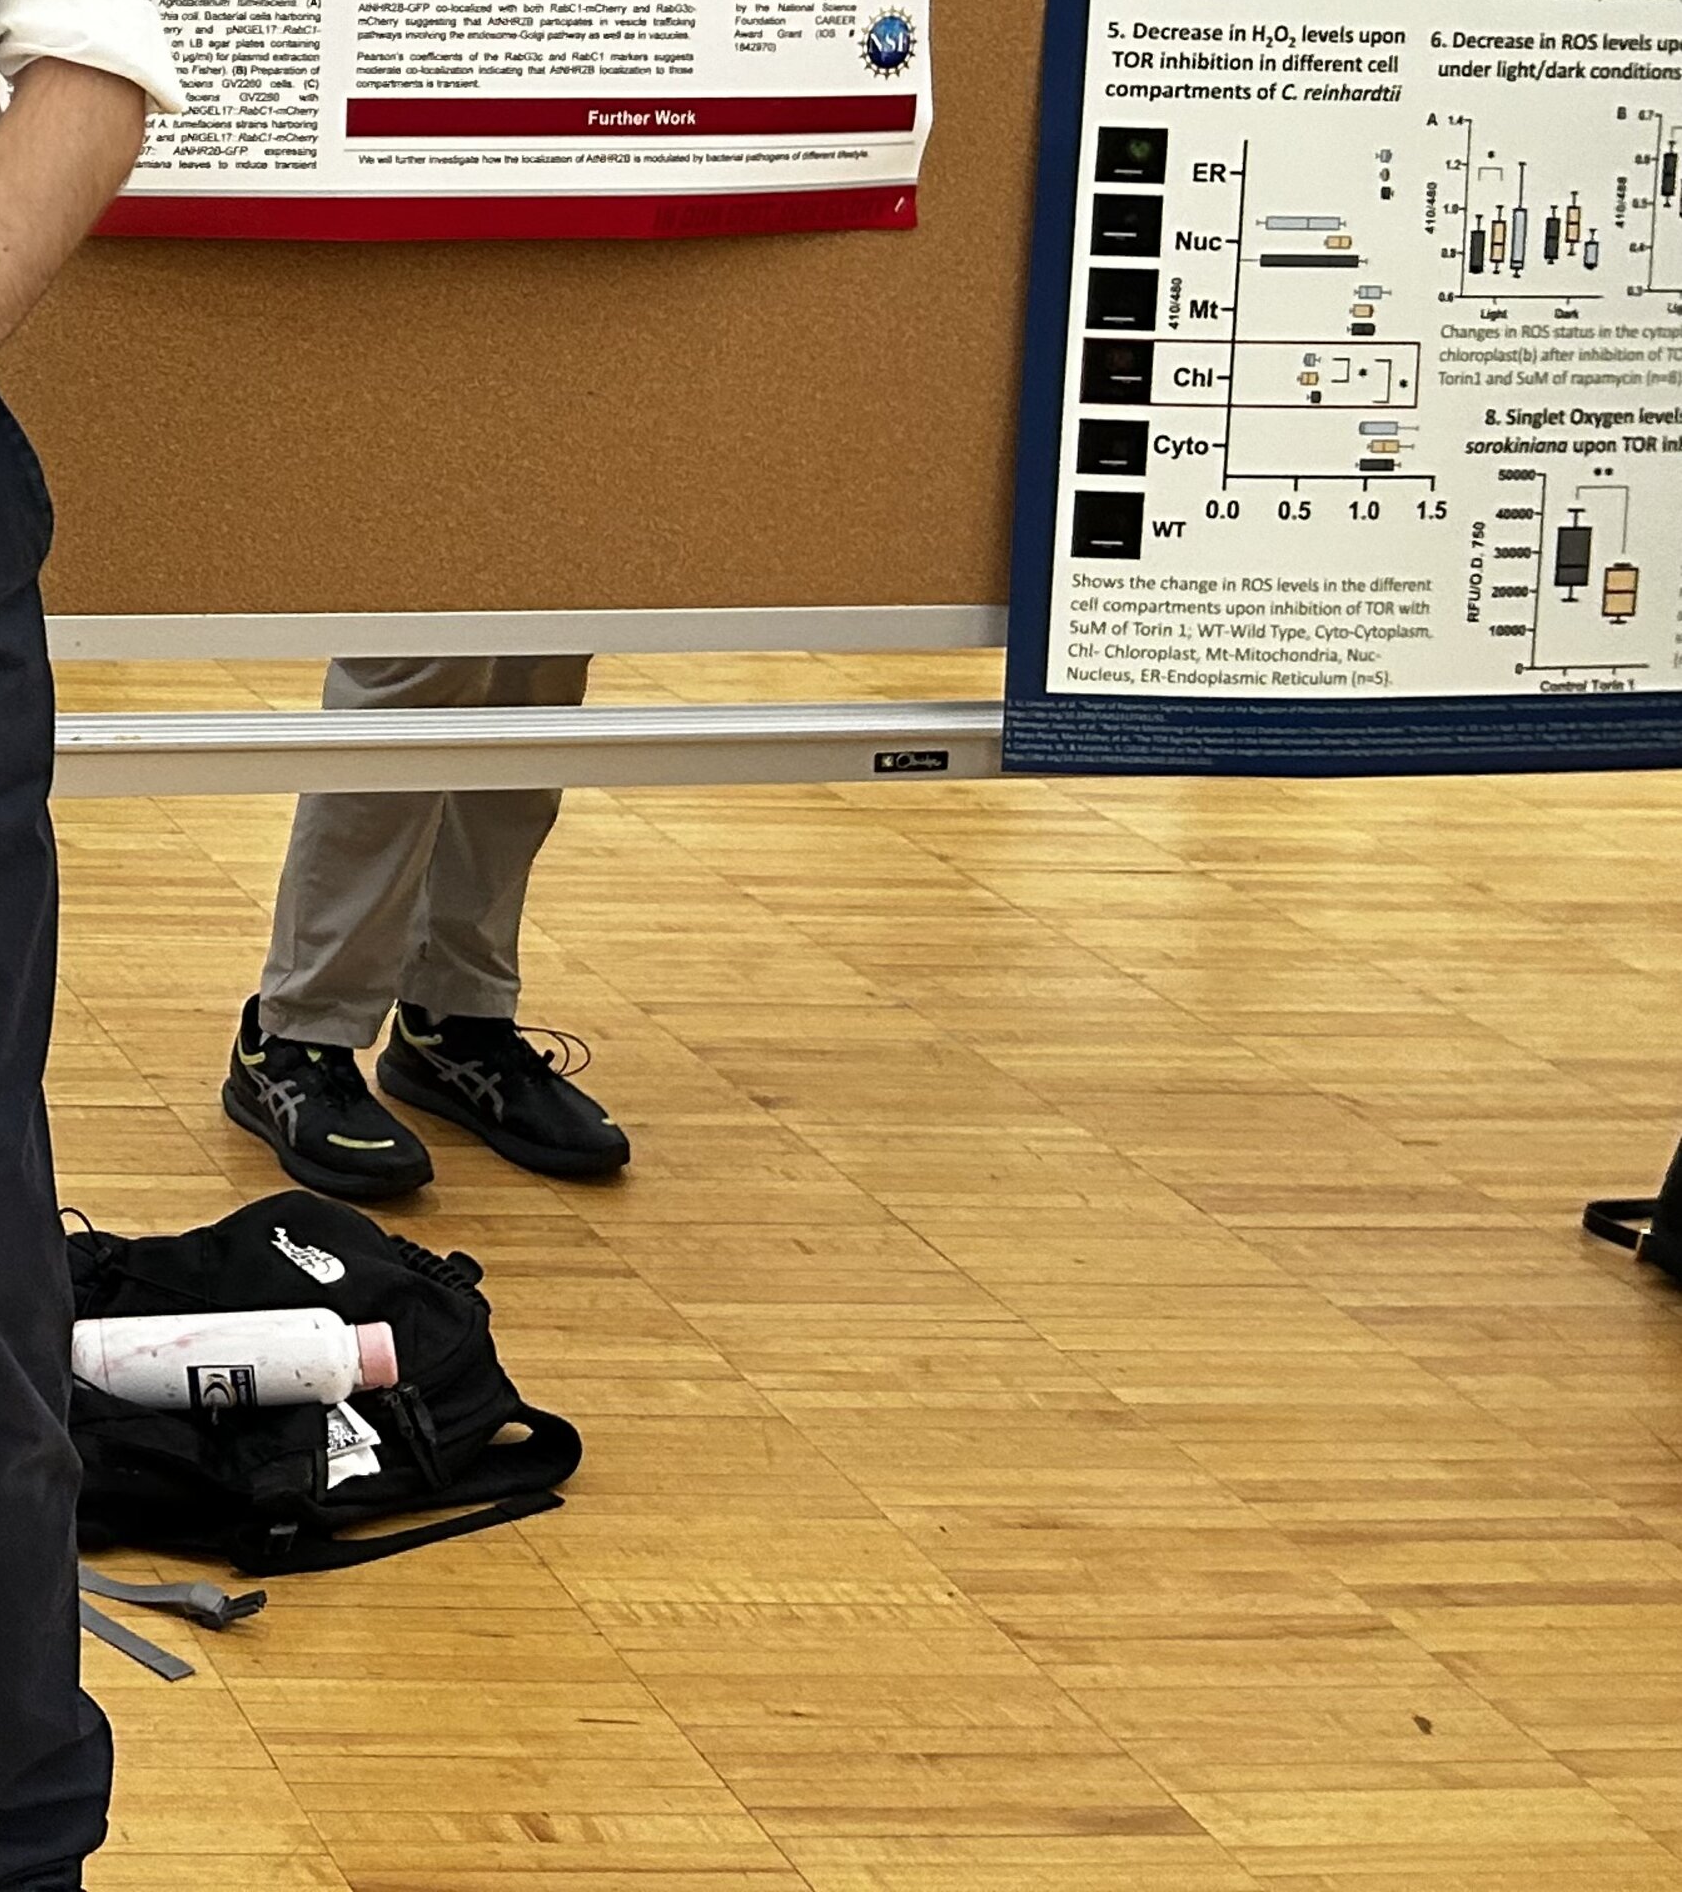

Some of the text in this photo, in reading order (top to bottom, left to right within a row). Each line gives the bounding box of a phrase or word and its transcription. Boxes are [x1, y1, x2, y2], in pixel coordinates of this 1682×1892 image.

[1107, 21, 1124, 38] 5.
[1132, 22, 1222, 40] Decrease
[1228, 24, 1245, 41] in
[1302, 25, 1353, 43] levels
[1359, 30, 1405, 47] upon
[1112, 50, 1398, 72] TOR inhibition in different cell
[588, 109, 695, 125] Further Work
[1193, 164, 1226, 183] ER
[1176, 232, 1223, 252] Nuc
[1189, 301, 1219, 320] Mt
[1173, 368, 1214, 388] Chl
[1153, 436, 1209, 460] Cyto
[1205, 499, 1239, 519] 0.0
[1278, 500, 1310, 520] 0.5
[1348, 500, 1379, 520] 1.0
[1416, 500, 1446, 519] 1.5
[1152, 521, 1186, 537] WT
